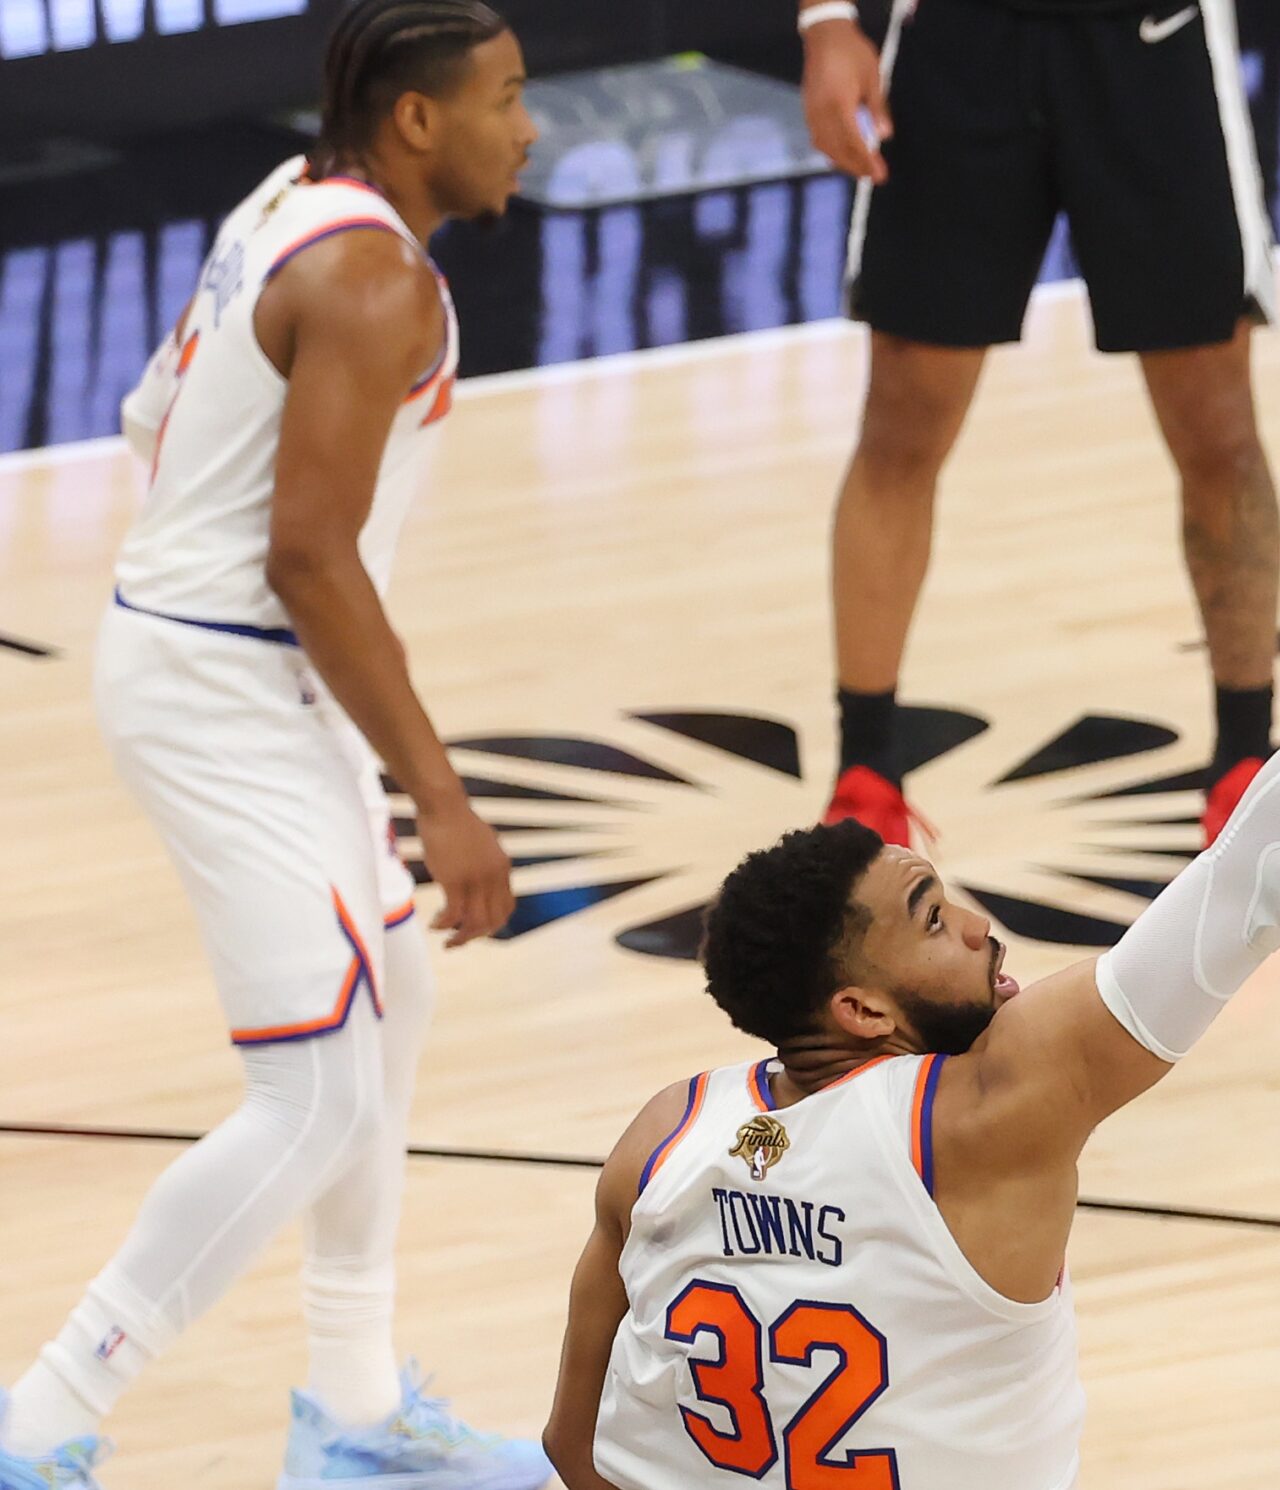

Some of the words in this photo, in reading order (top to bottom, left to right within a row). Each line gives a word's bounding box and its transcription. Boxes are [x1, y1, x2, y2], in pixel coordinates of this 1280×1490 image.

[730, 1126, 785, 1154] Finals
[712, 1187, 846, 1267] TOWNS
[664, 1278, 901, 1490] 32
